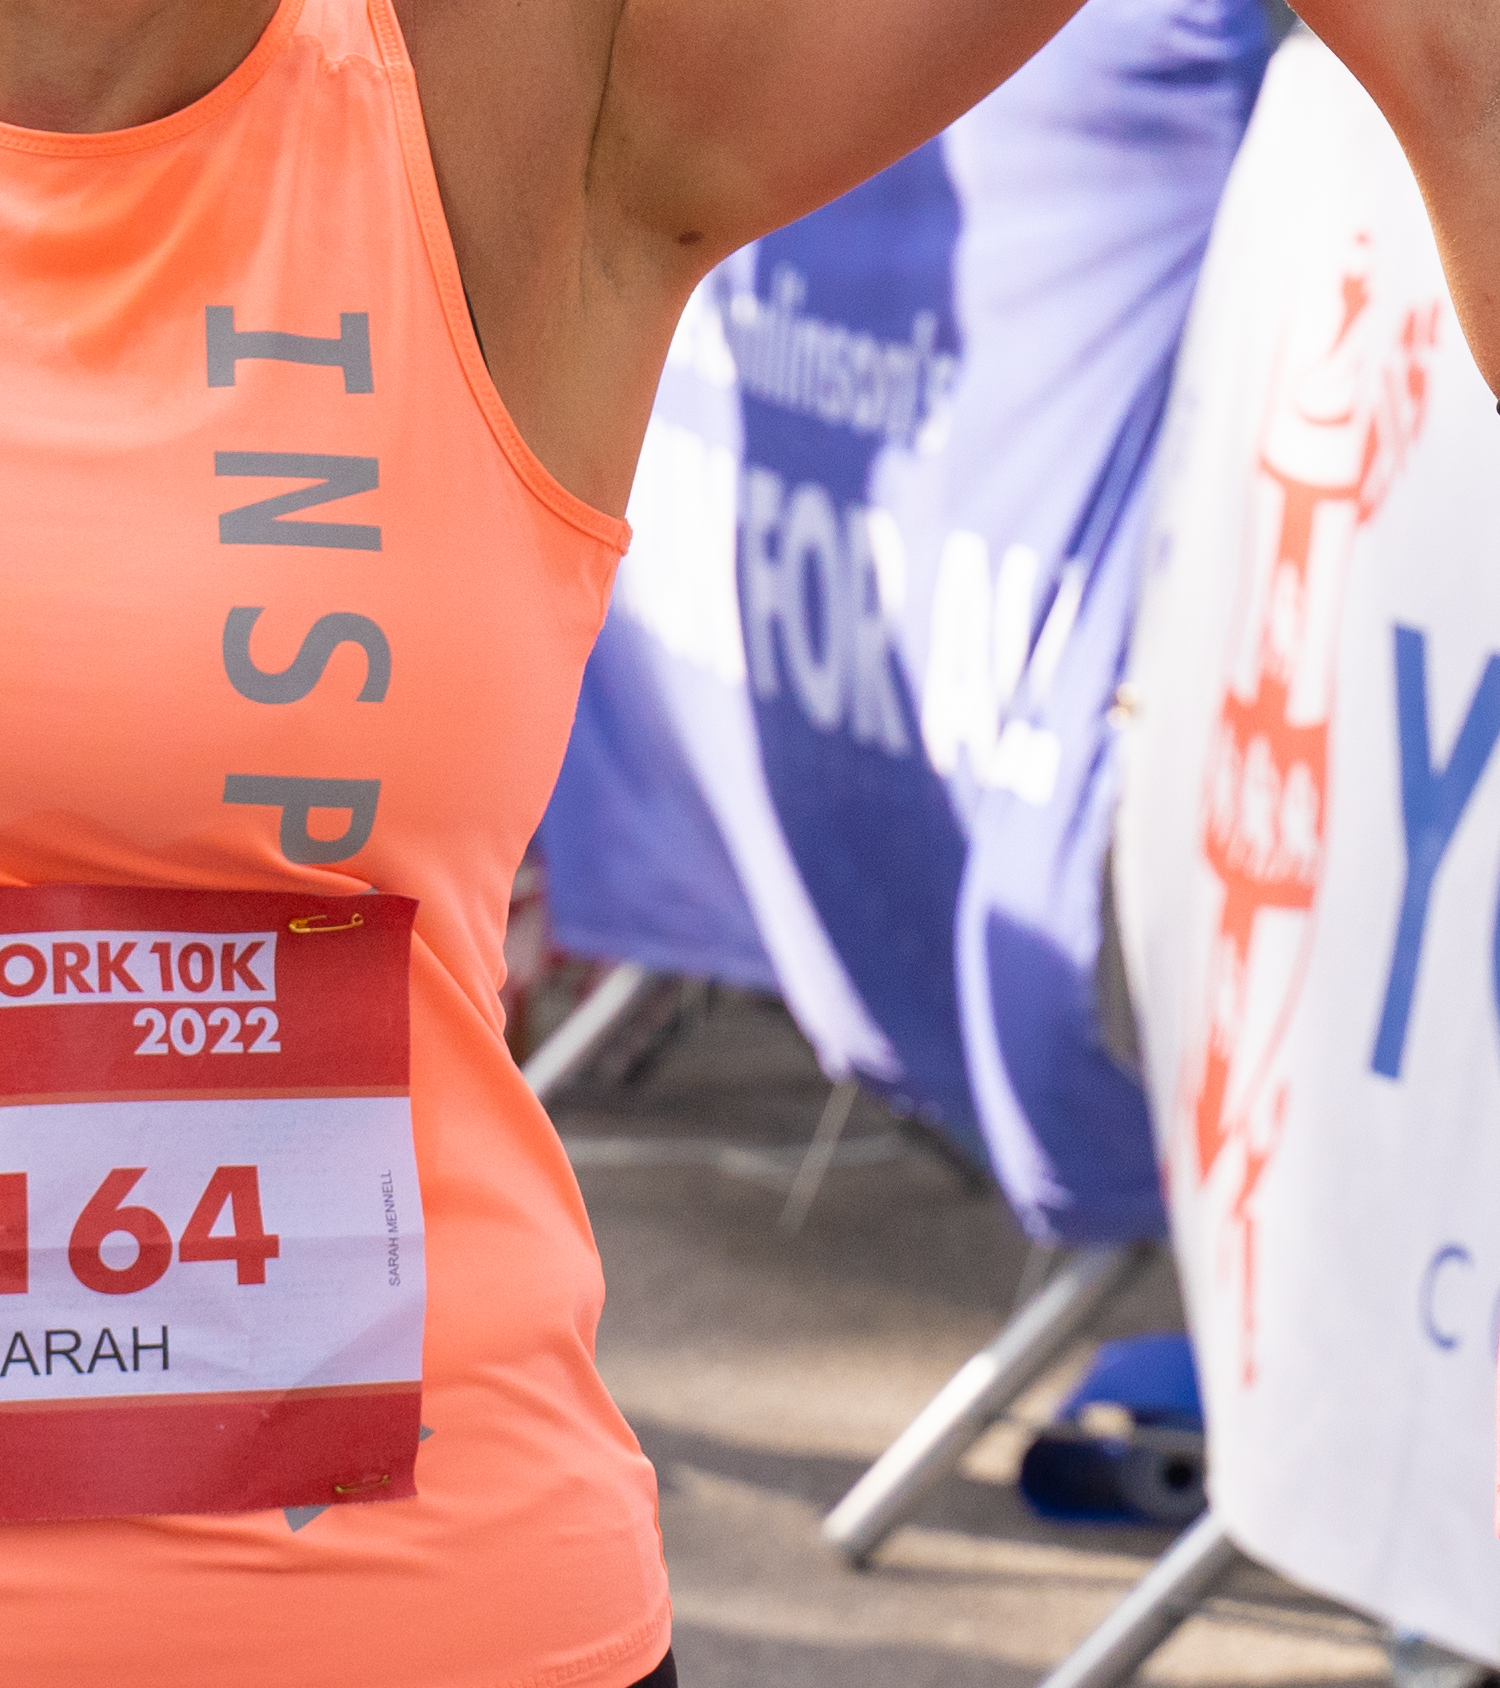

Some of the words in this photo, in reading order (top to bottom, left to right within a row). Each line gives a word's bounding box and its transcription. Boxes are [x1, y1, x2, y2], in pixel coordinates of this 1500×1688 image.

[151, 938, 267, 994] 10K
[134, 1006, 282, 1056] 2022
[381, 1168, 399, 1233] MENNELL
[388, 1237, 401, 1287] SARAH
